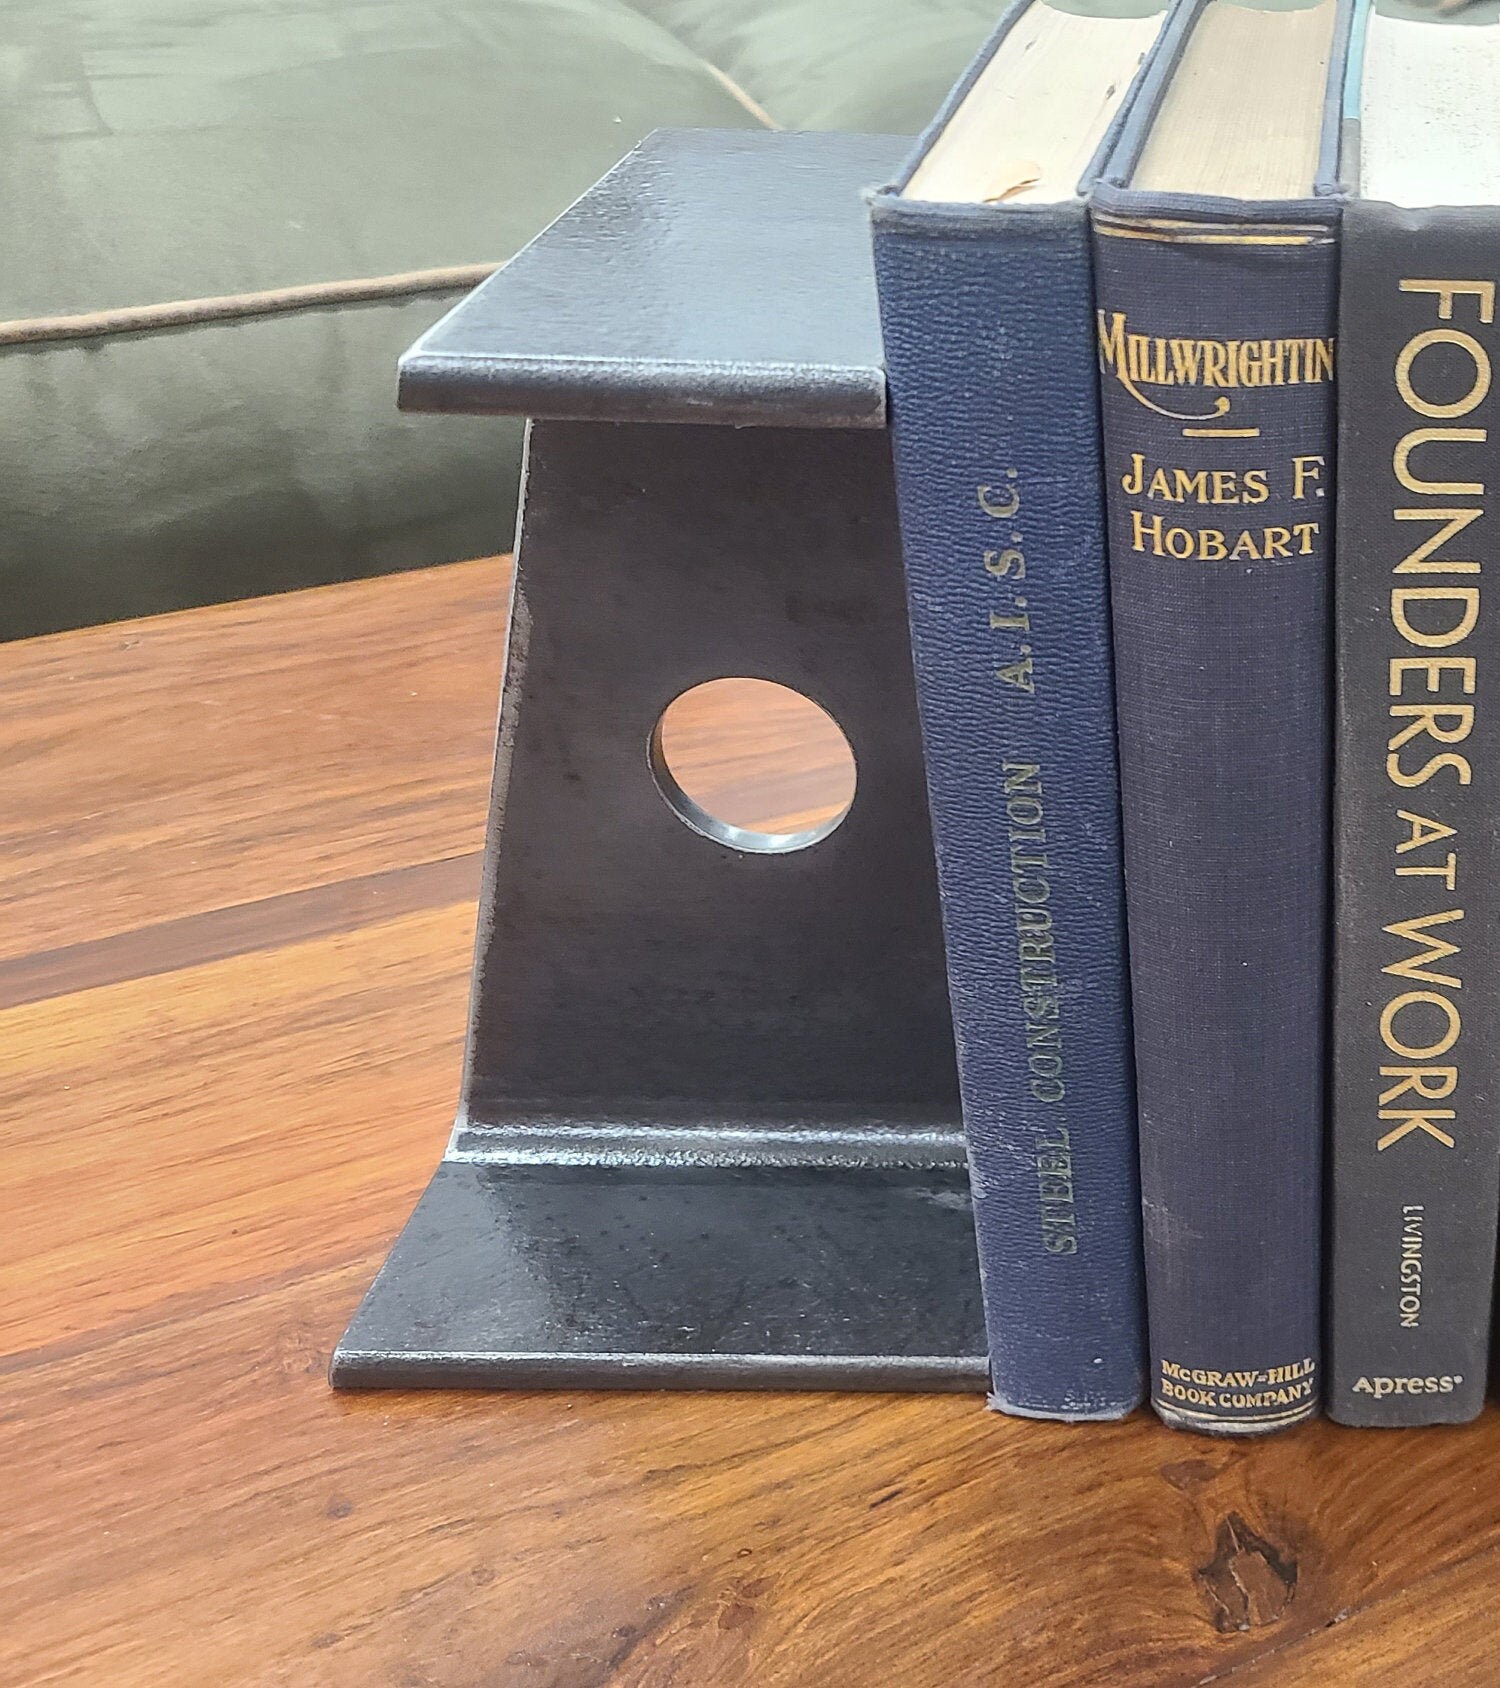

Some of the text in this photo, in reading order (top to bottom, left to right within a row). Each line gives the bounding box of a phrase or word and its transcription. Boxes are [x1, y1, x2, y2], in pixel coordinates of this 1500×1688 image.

[1121, 453, 1326, 504] JAMES F.
[1130, 510, 1320, 561] HOBART
[1377, 279, 1496, 1152] FOUNDERS AT WORK
[1002, 760, 1066, 1103] CONSTRUCTION
[1034, 1126, 1079, 1256] STEEL
[1400, 1205, 1424, 1328] LIVINGSTON
[1161, 1377, 1314, 1408] BOOK COMPANY
